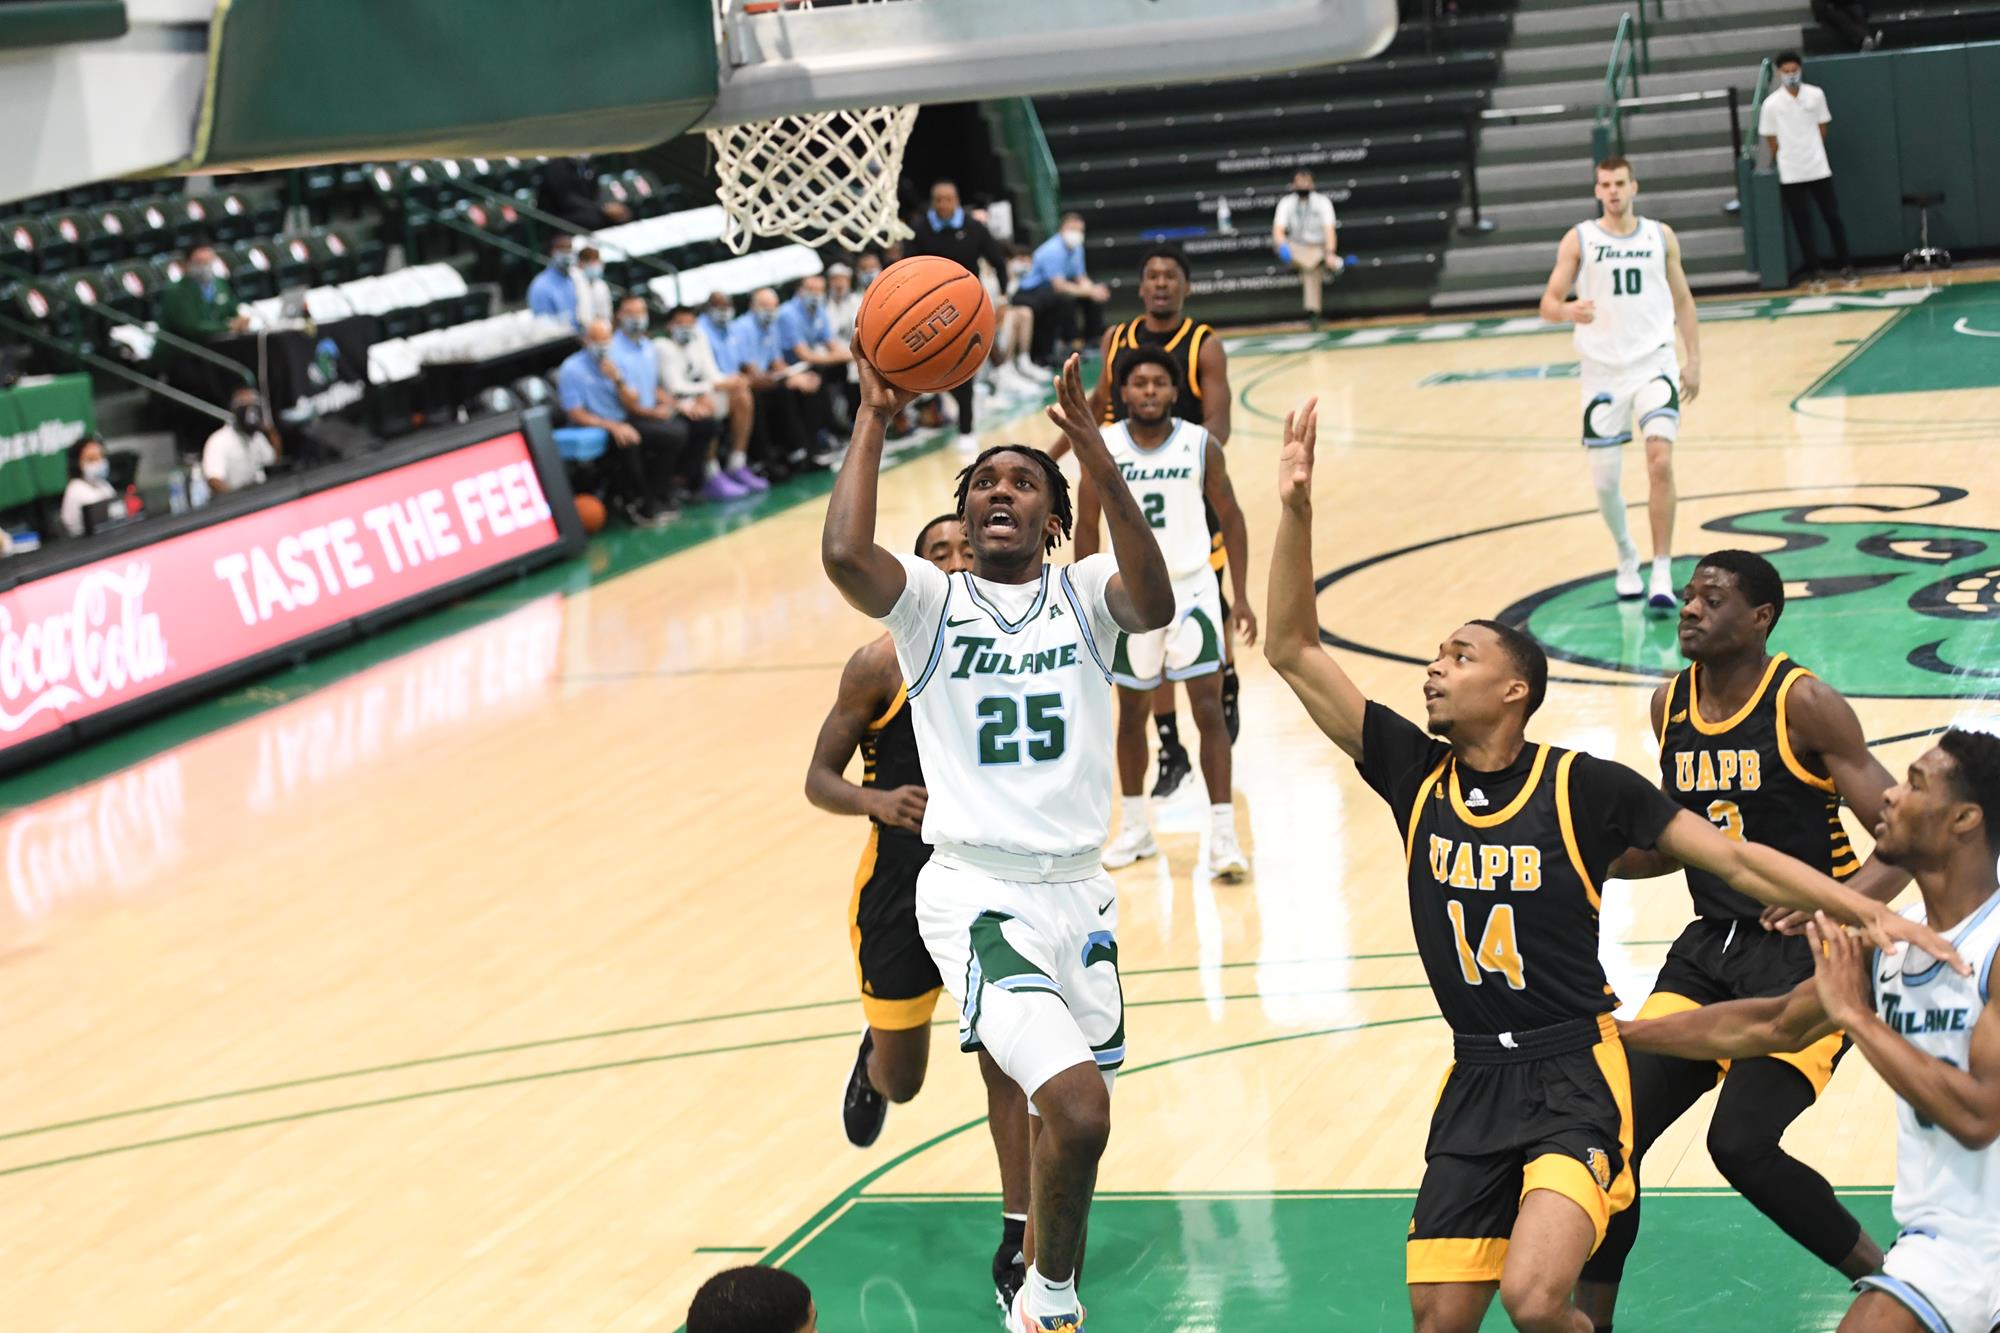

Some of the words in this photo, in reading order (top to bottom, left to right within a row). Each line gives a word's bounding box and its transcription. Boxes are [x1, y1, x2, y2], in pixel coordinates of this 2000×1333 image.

[1595, 246, 1653, 262] TULANE
[1612, 268, 1642, 295] 10
[905, 304, 960, 353] ELITE
[1143, 493, 1166, 528] 2
[214, 518, 374, 626] TASTE
[363, 489, 461, 573] THE
[951, 635, 1078, 679] TULANE
[976, 691, 1067, 767] 25
[1675, 749, 1761, 792] UAPB
[1429, 833, 1542, 891] UAPB
[1447, 899, 1526, 990] 14
[1882, 992, 1969, 1036] TULANE
